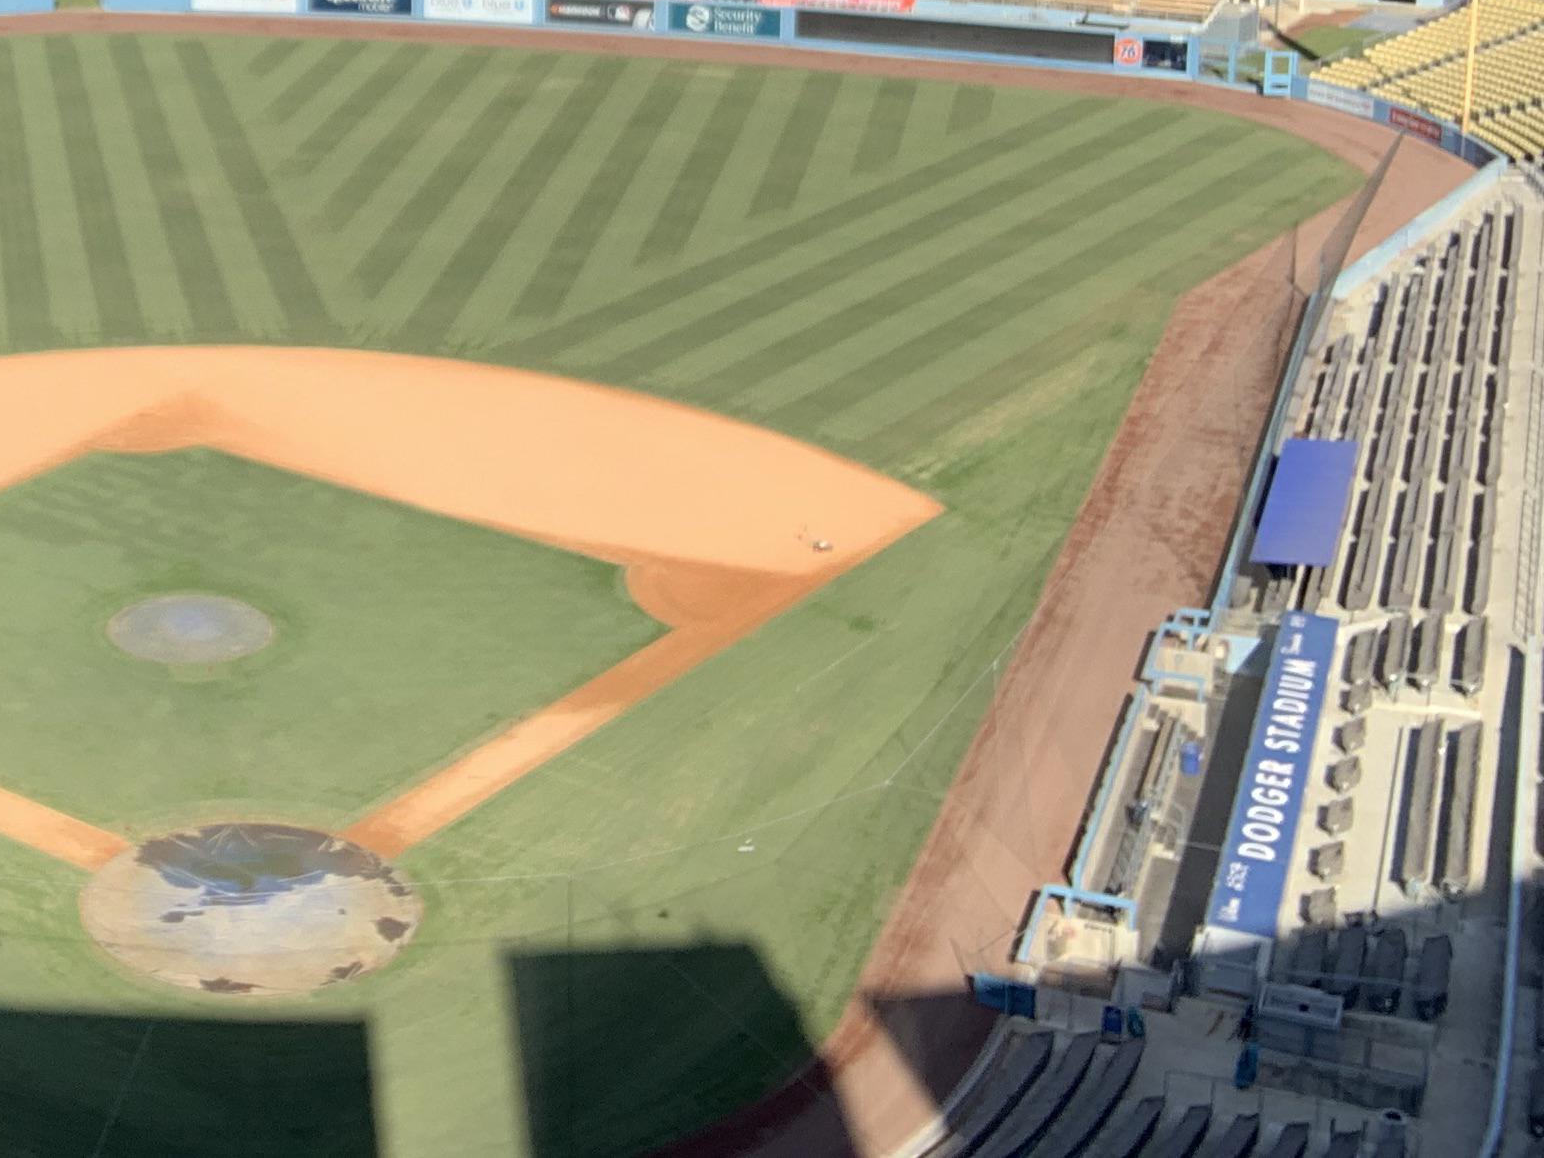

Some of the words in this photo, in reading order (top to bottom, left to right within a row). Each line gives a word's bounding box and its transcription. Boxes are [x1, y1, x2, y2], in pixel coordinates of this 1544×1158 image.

[713, 7, 762, 23] Security
[1119, 45, 1136, 59] 76
[1263, 659, 1318, 754] STADIUM
[1238, 756, 1295, 862] DODGER
